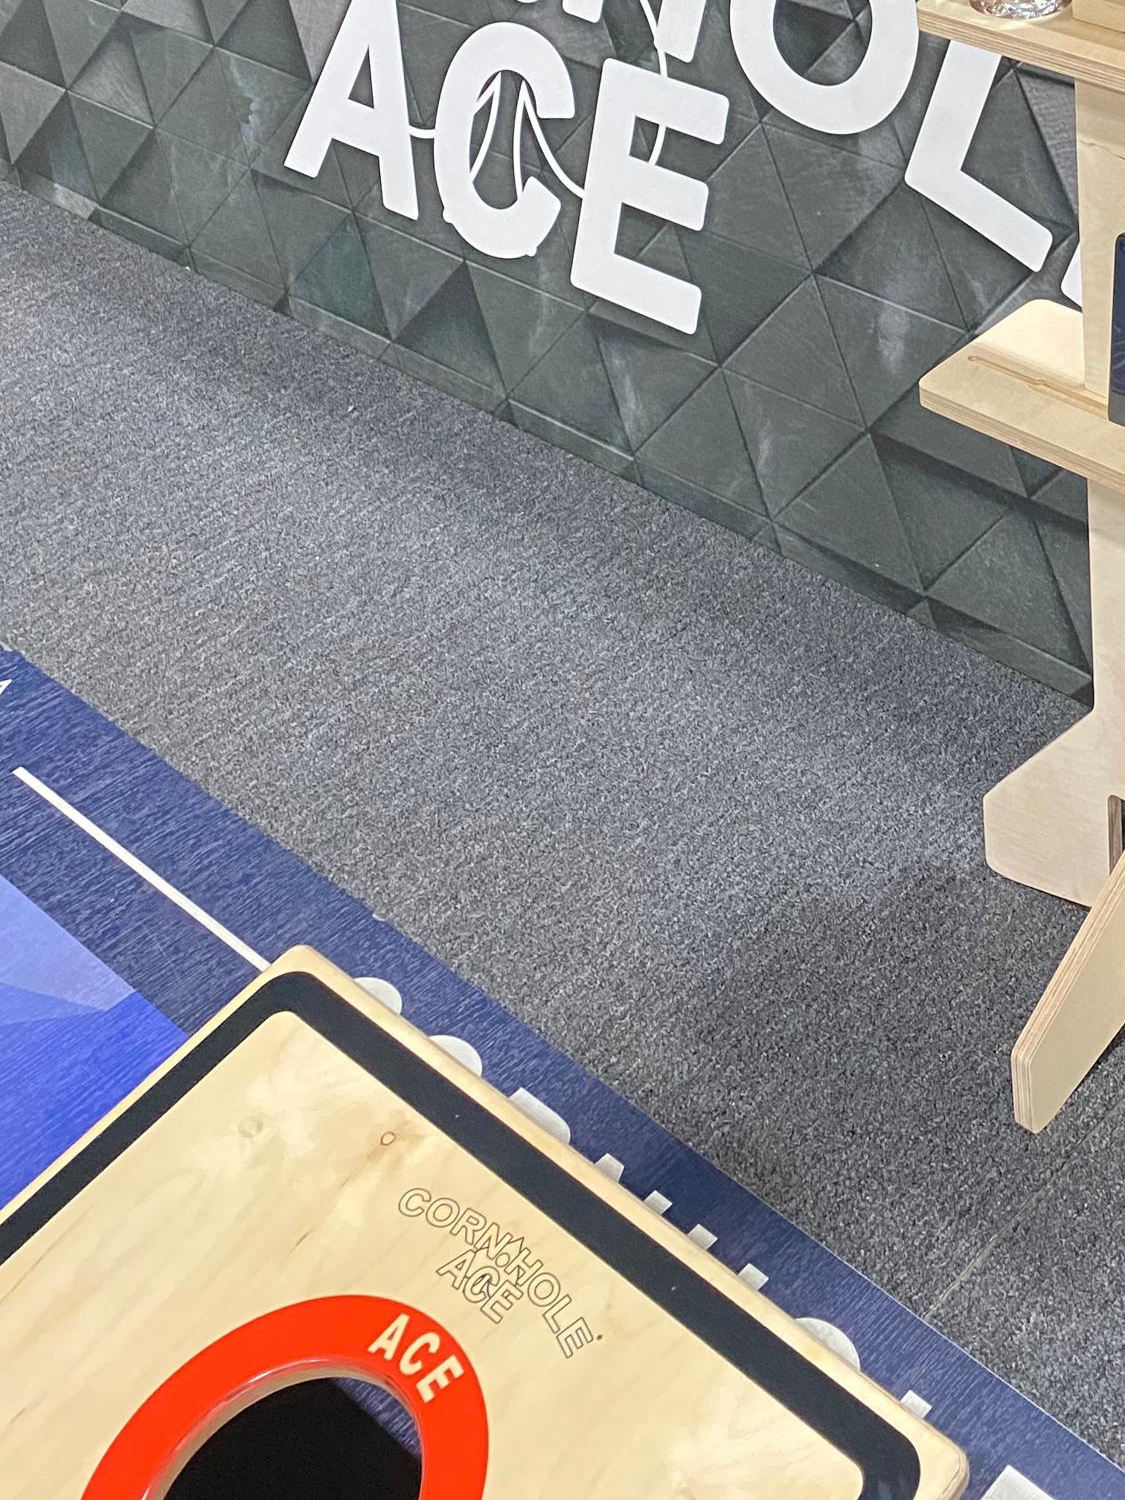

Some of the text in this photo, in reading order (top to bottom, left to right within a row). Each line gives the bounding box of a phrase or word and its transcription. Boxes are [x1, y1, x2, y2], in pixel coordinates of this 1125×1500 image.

[398, 1187, 595, 1359] CORNHOLE
[436, 1248, 523, 1324] ACE
[367, 1313, 464, 1403] ACE
